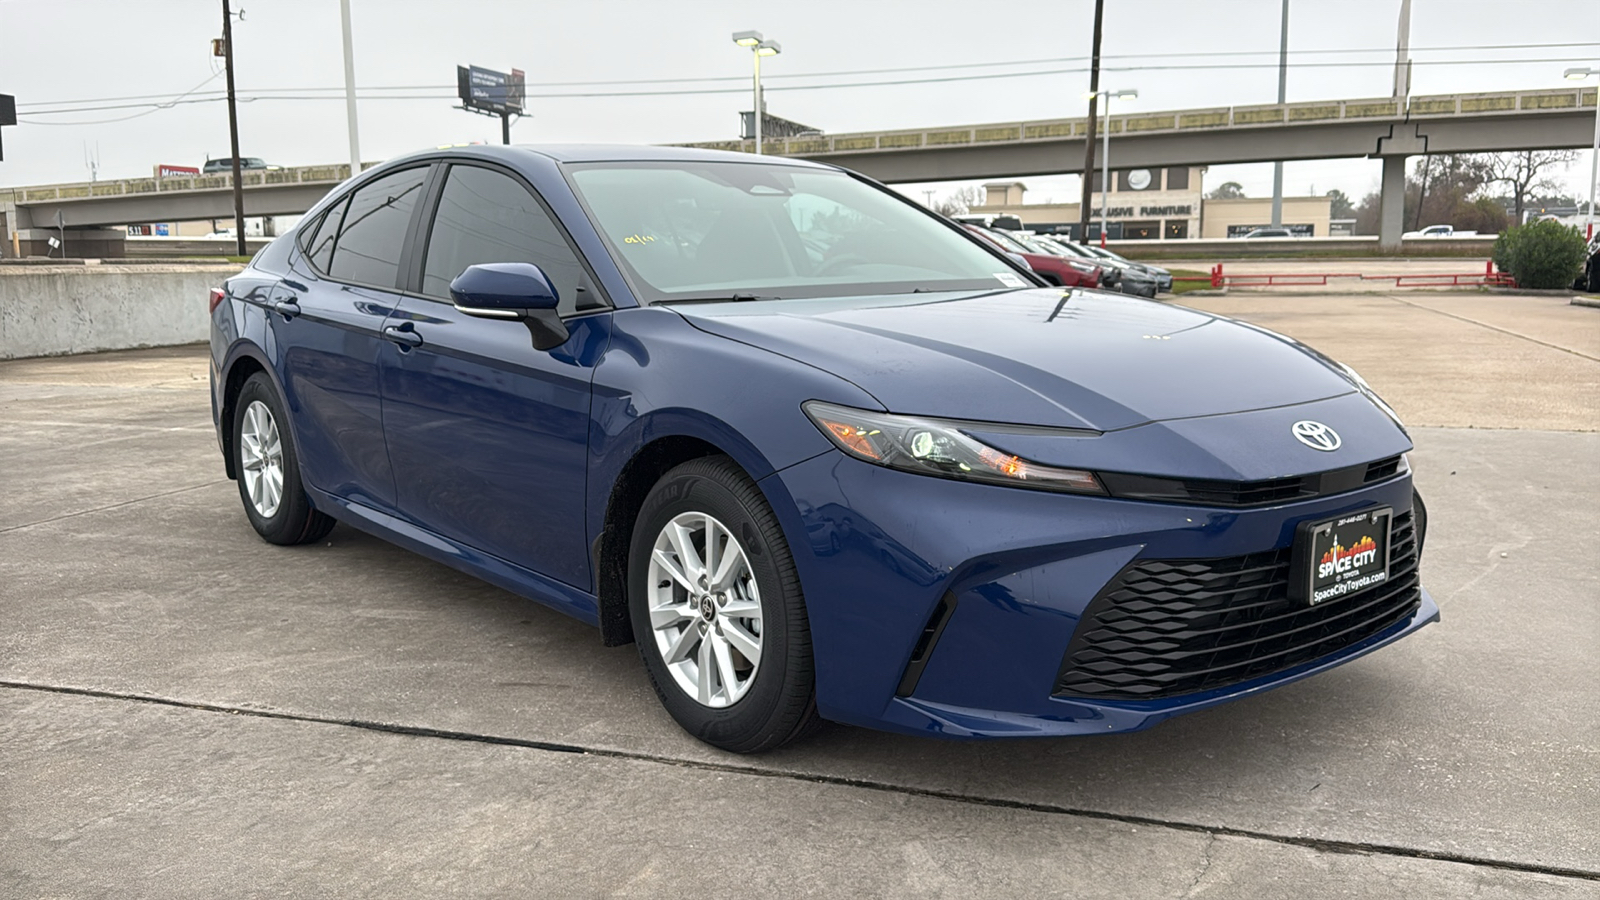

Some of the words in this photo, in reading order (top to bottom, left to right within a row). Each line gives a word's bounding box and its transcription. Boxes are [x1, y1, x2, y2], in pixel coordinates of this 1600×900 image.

[1091, 207, 1134, 217] XCUSIVE
[1140, 205, 1192, 216] FURNITURE
[1318, 554, 1352, 578] SPACE
[1353, 548, 1376, 567] CITY
[1343, 569, 1360, 579] TOYOTA
[1314, 571, 1385, 602] SpaceCityToyota.com
